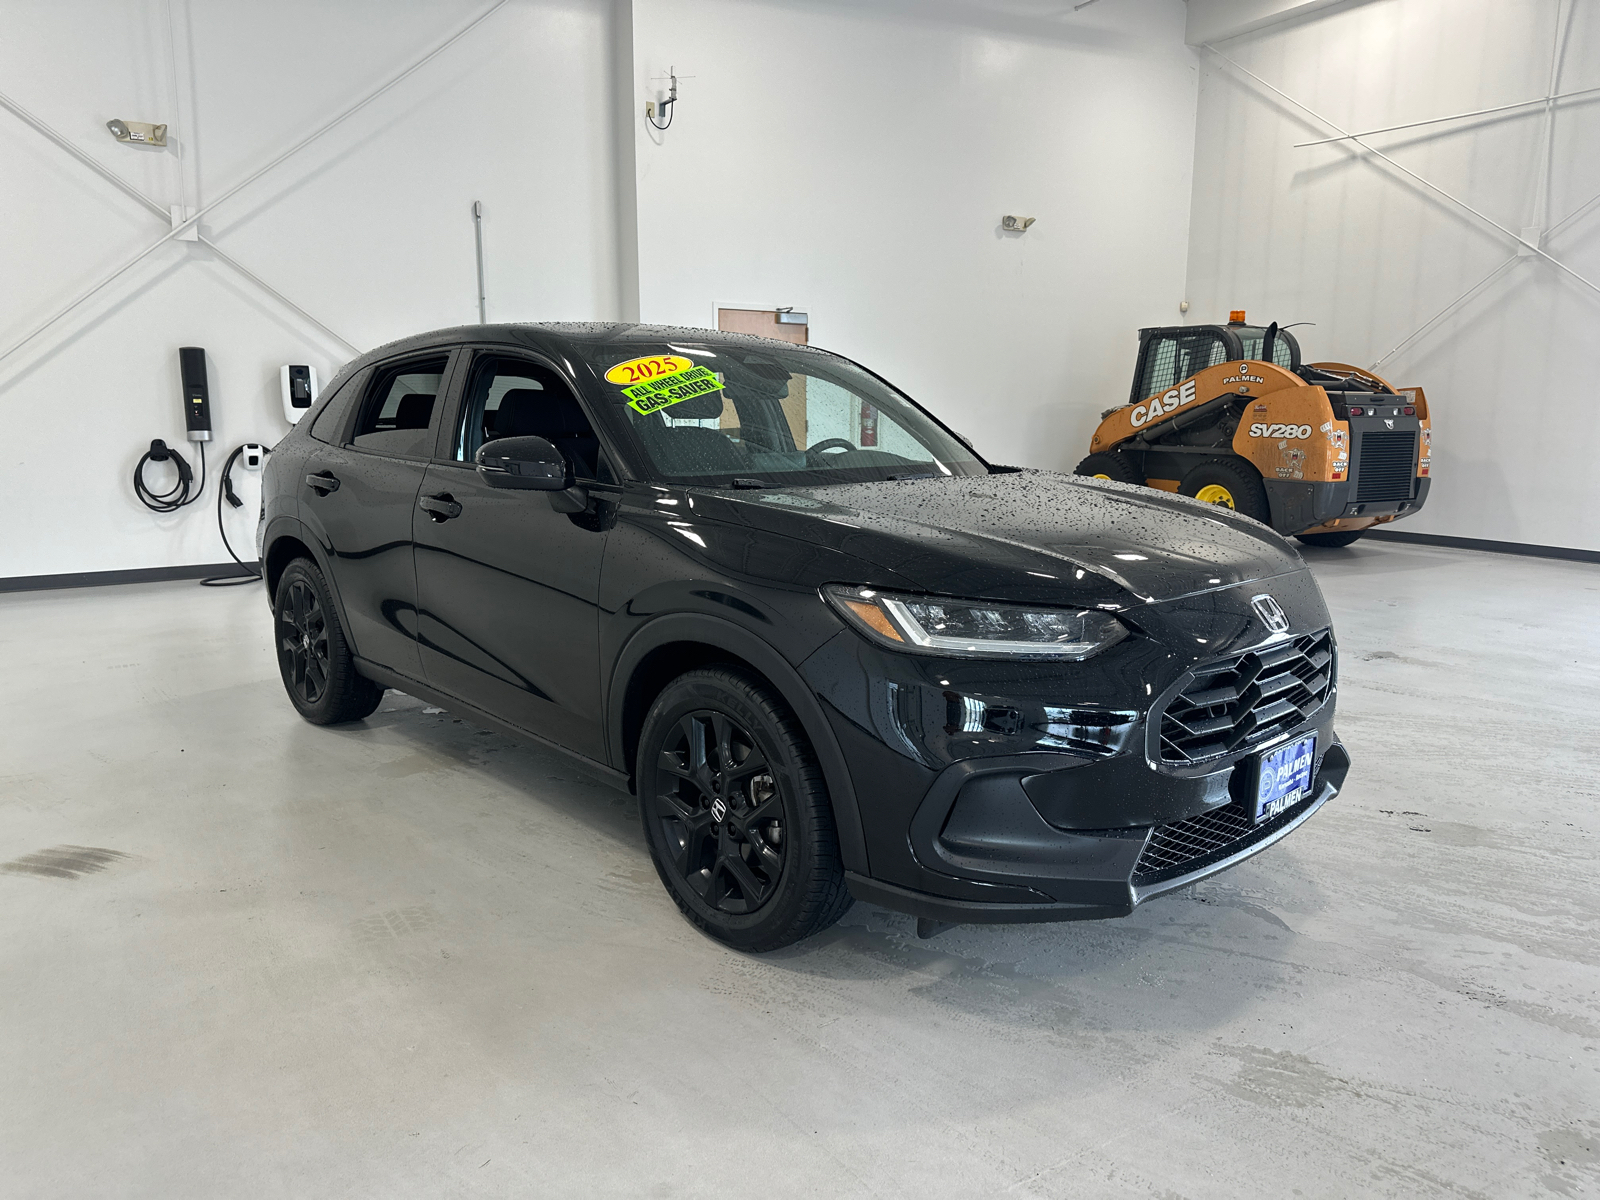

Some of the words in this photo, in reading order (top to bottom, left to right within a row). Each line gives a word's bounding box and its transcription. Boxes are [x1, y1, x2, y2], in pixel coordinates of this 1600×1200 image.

[622, 357, 678, 383] 2025
[630, 385, 650, 399] ALL
[650, 375, 681, 393] WHEEL
[683, 367, 710, 381] DRIVE
[1223, 375, 1264, 384] PALMEN
[635, 378, 716, 412] GAS-SAVER
[1130, 379, 1196, 428] CASE
[1248, 422, 1313, 440] SV280
[716, 690, 764, 730] KELLY
[1276, 752, 1313, 782] PALMEN
[1270, 788, 1302, 816] PALMEN
